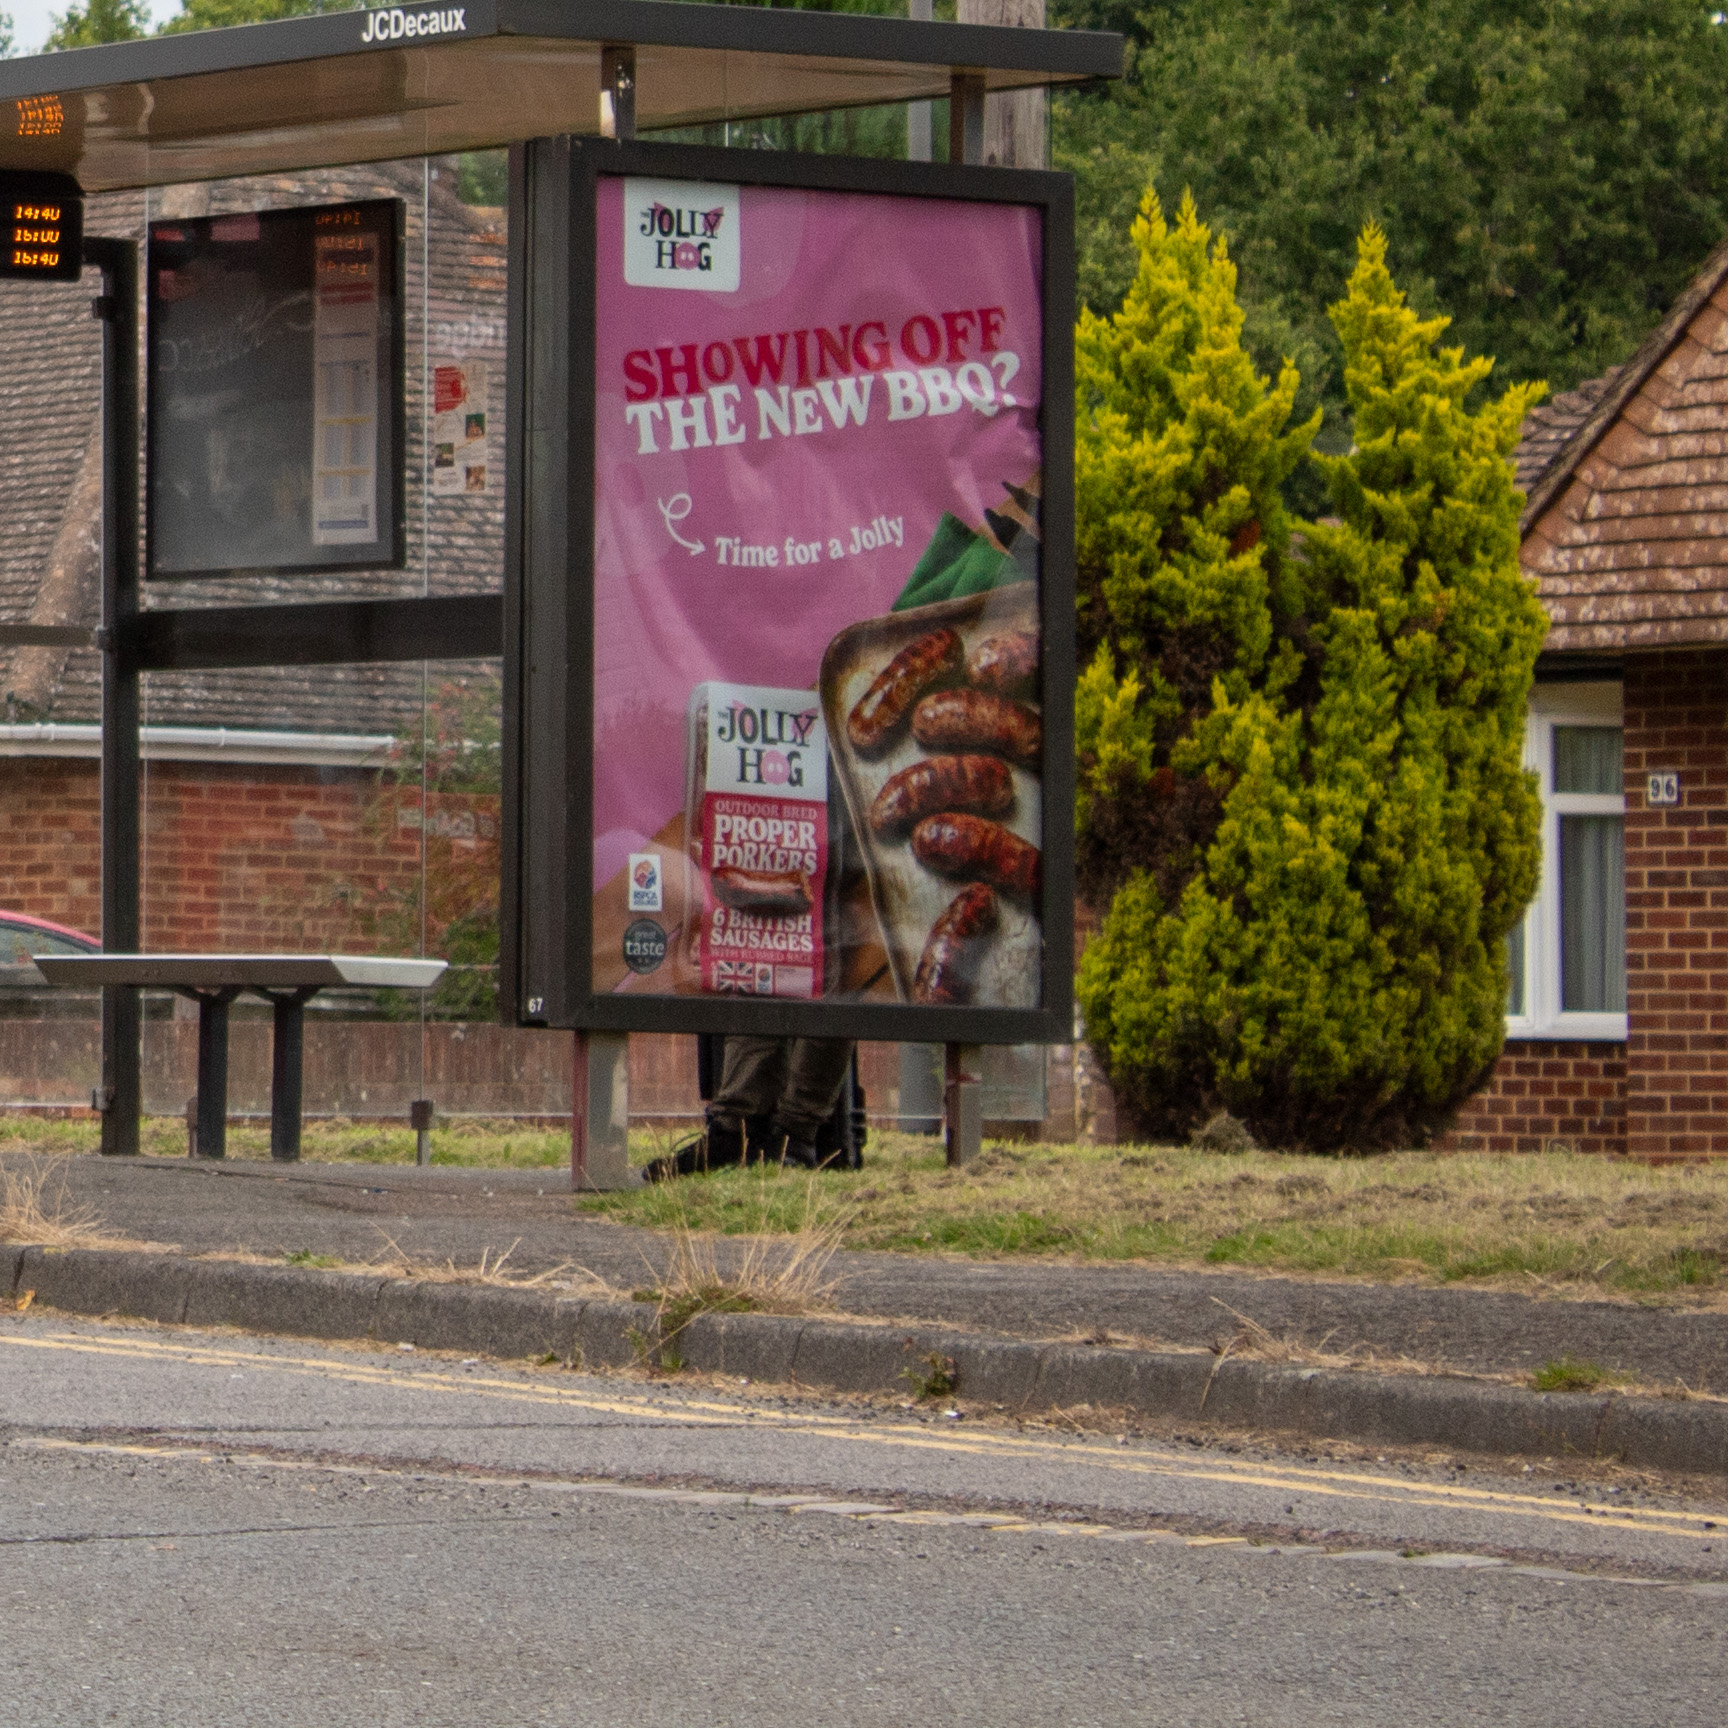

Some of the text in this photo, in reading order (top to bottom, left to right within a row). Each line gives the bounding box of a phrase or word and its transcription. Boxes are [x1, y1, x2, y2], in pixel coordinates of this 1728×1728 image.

[361, 8, 466, 42] JCDecaux
[640, 207, 724, 239] JOLLY
[623, 306, 1007, 403] SHOWING OFF
[626, 351, 1021, 455] THE NEW BBQ?
[715, 515, 904, 567] Time for a Jolly
[718, 707, 818, 747] JOLLY
[714, 799, 779, 818] OUTDOOR
[714, 813, 817, 851] PROPER
[712, 841, 817, 876] PORKERS
[712, 907, 725, 927] 6
[626, 941, 665, 956] taste
[710, 927, 813, 952] SAUSAGES
[528, 997, 543, 1013] 67
